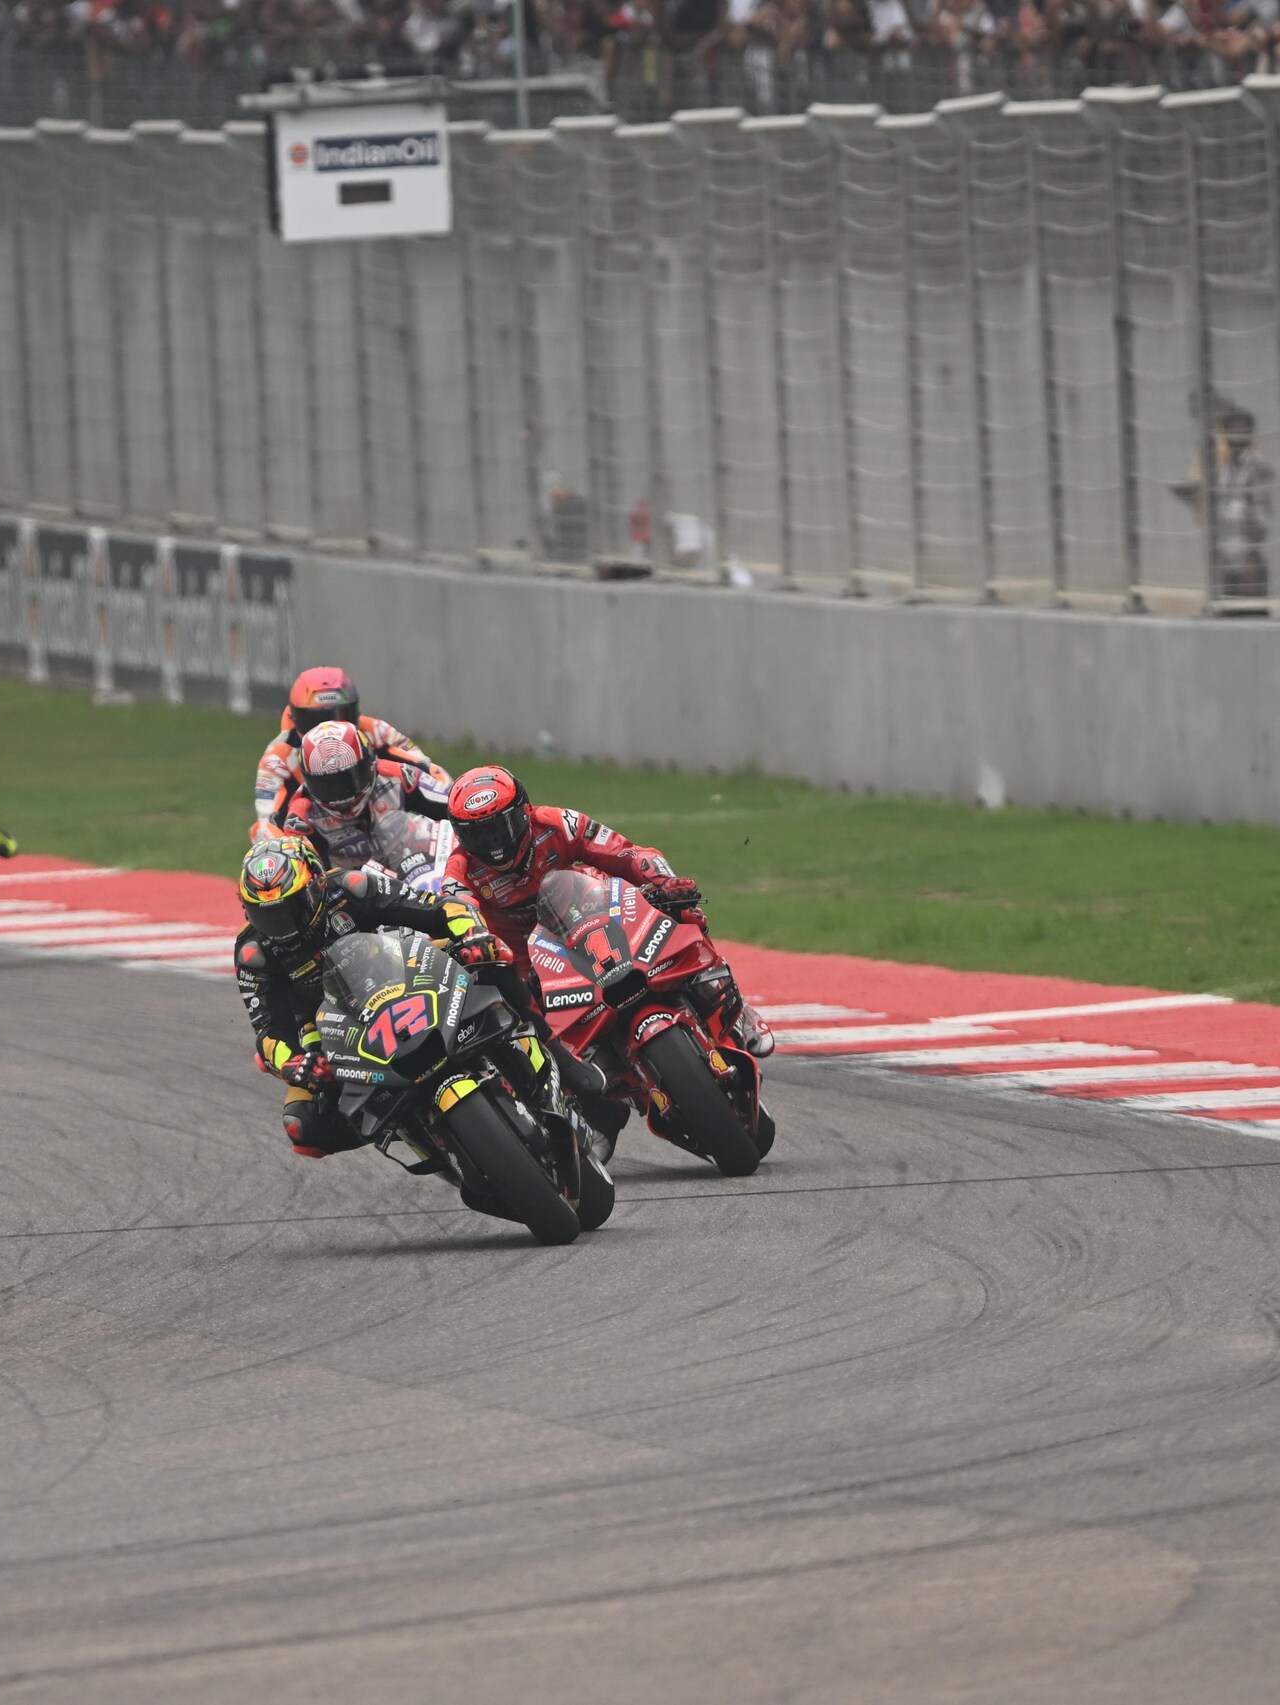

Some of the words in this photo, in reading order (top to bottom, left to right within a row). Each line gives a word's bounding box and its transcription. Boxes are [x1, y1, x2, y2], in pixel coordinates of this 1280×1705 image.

[584, 927, 622, 977] 1
[638, 918, 673, 964] Lenovo
[536, 953, 566, 973] riello
[369, 986, 402, 1009] BARDAHL
[446, 974, 468, 1028] mooneygo
[545, 991, 593, 1009] Lenovo
[366, 993, 429, 1058] 72
[457, 1021, 476, 1044] ebay
[634, 1012, 673, 1042] Lenovo
[336, 1067, 385, 1085] mooneygo
